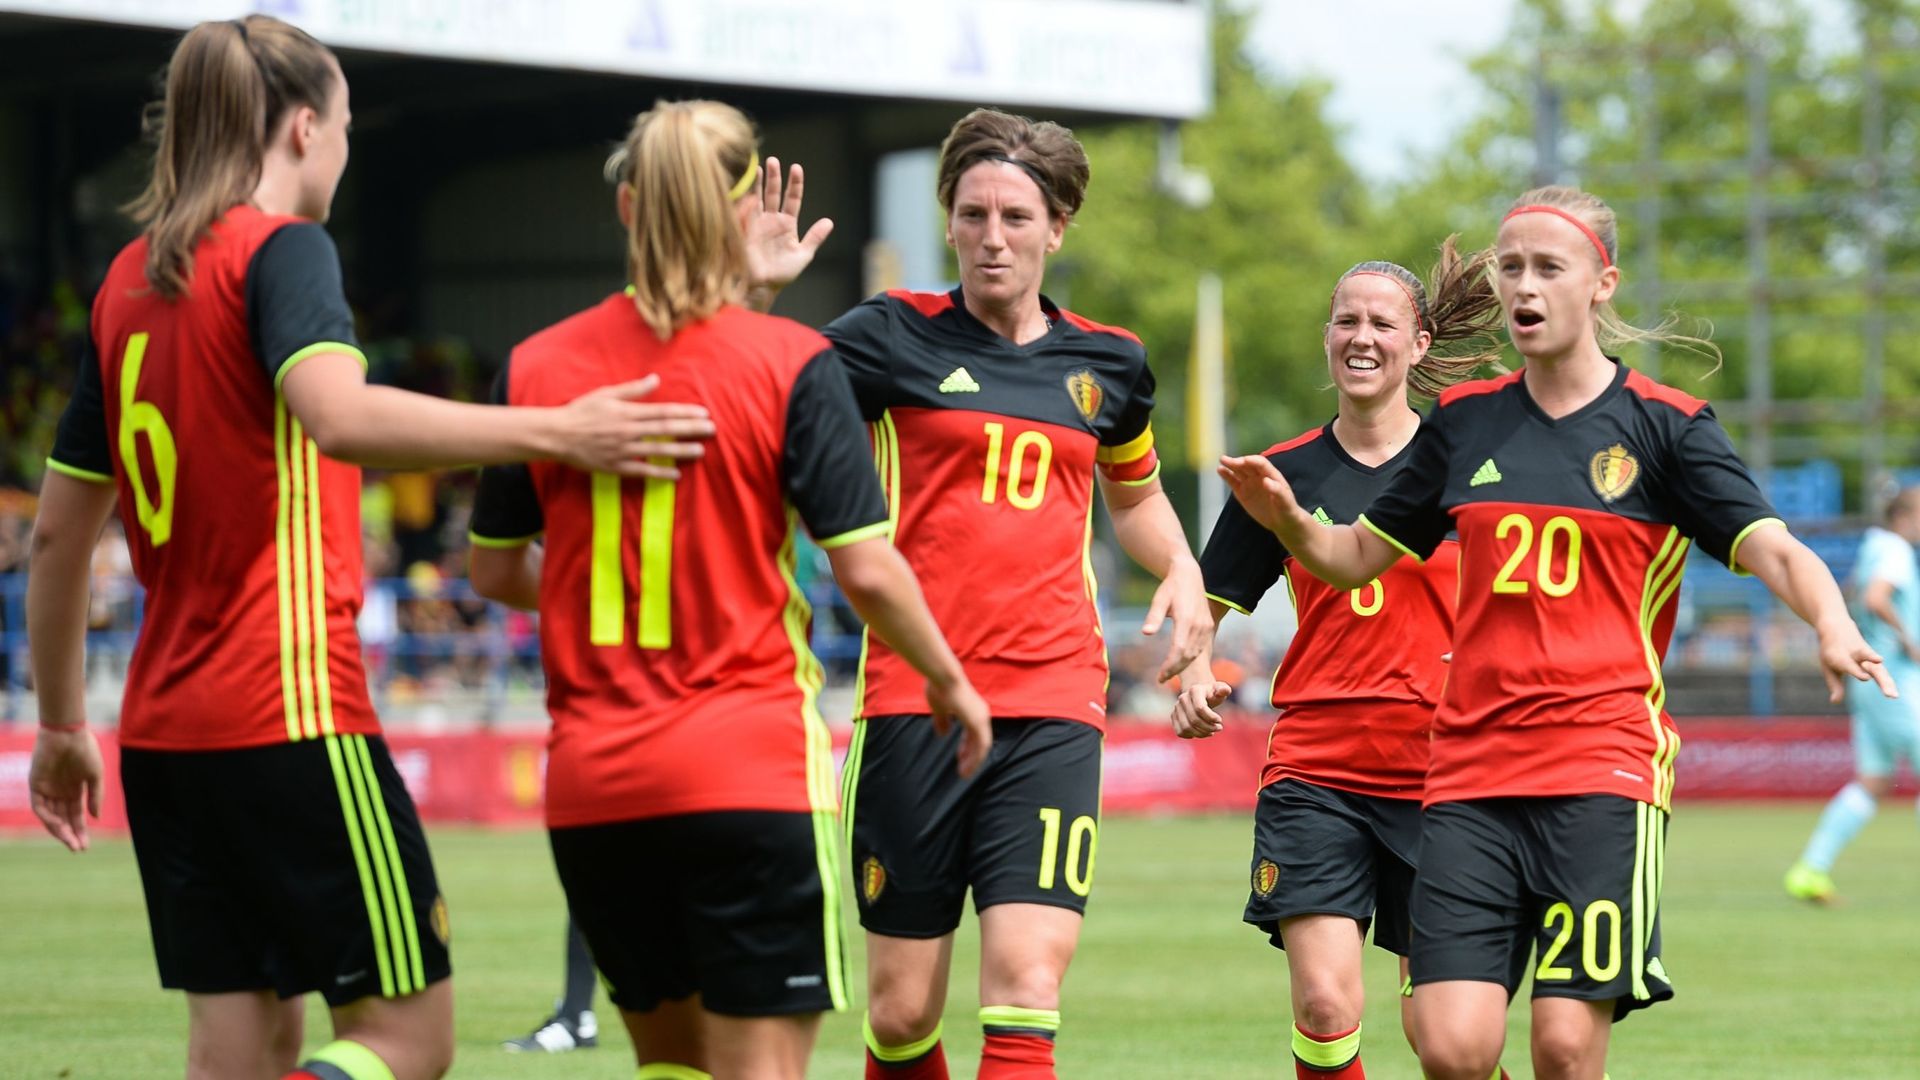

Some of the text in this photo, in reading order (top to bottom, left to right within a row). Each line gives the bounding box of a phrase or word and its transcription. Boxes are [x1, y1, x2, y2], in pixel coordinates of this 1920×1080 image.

[119, 332, 177, 546] 6
[981, 422, 1053, 511] 10
[590, 433, 676, 648] 11
[1492, 513, 1582, 597] 20
[1038, 808, 1098, 896] 10
[1535, 900, 1622, 983] 20
